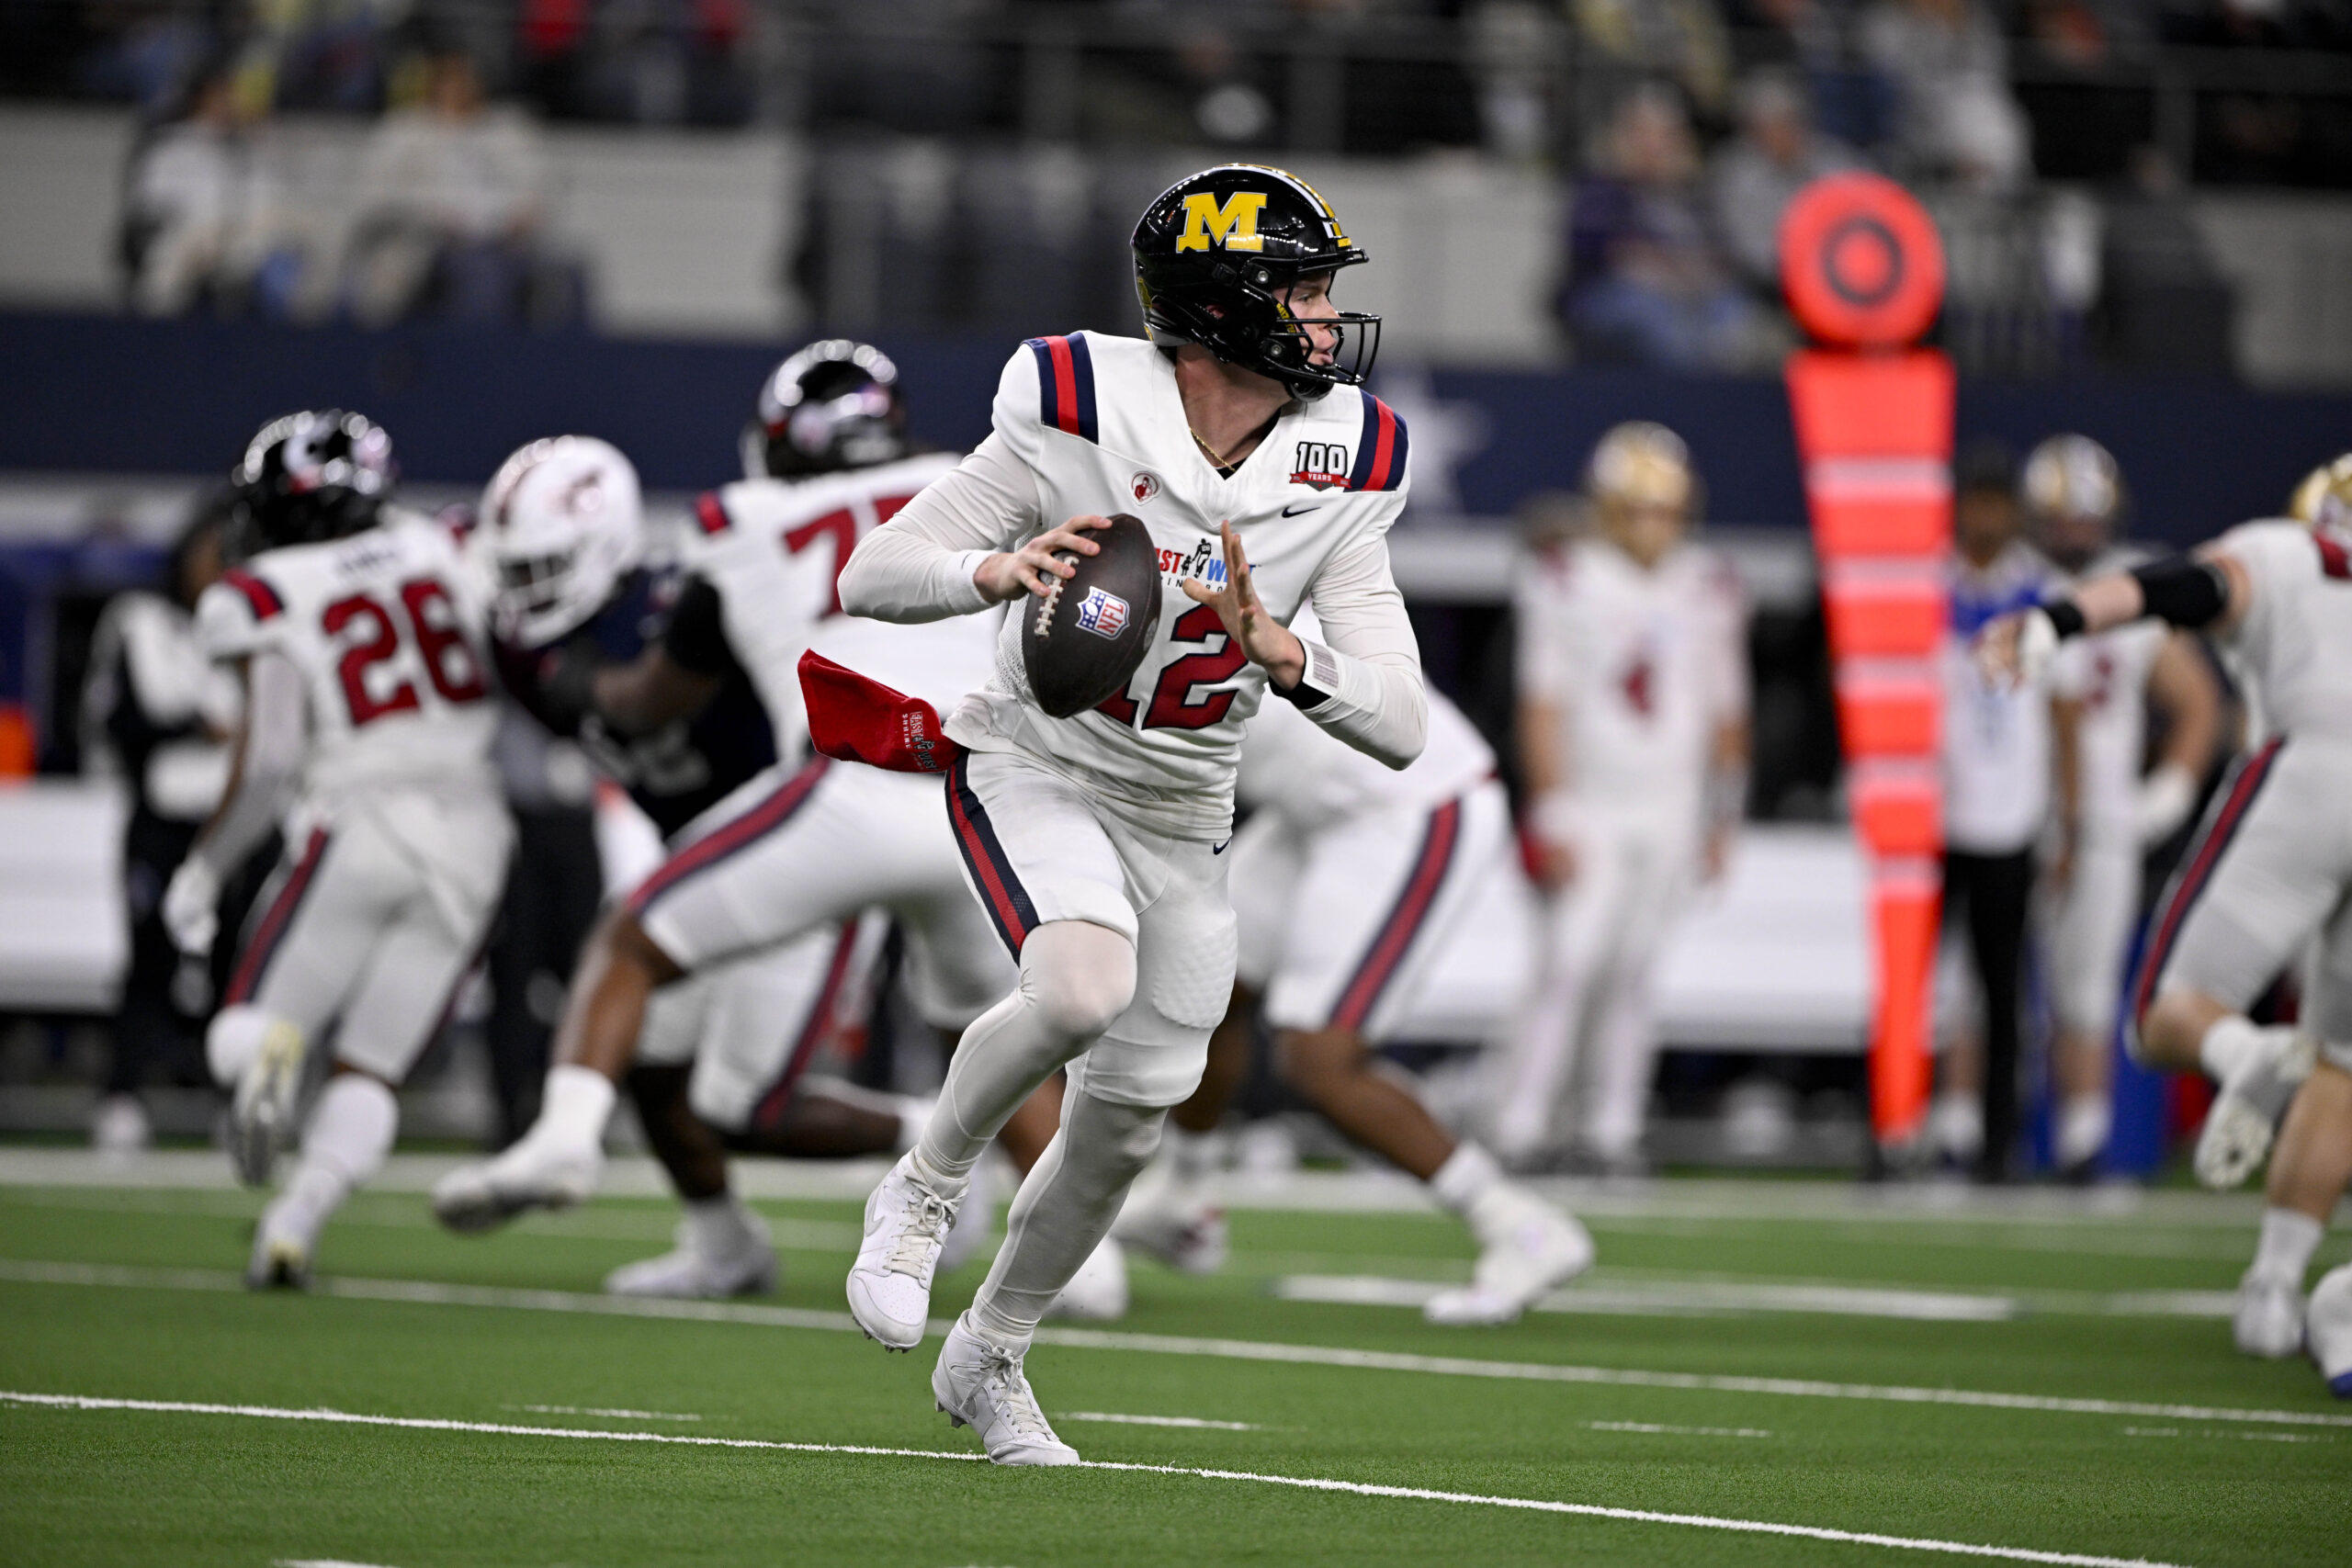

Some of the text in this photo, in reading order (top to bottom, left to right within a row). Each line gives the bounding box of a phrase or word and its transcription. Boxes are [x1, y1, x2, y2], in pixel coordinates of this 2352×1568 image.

[1176, 191, 1268, 254] M
[1295, 441, 1348, 477] 100
[1307, 472, 1332, 482] YEARS
[783, 492, 922, 623] 7
[1096, 603, 1125, 635] NFL
[322, 575, 489, 727] 26
[902, 713, 912, 750] SHRINE
[910, 711, 923, 738] EAST
